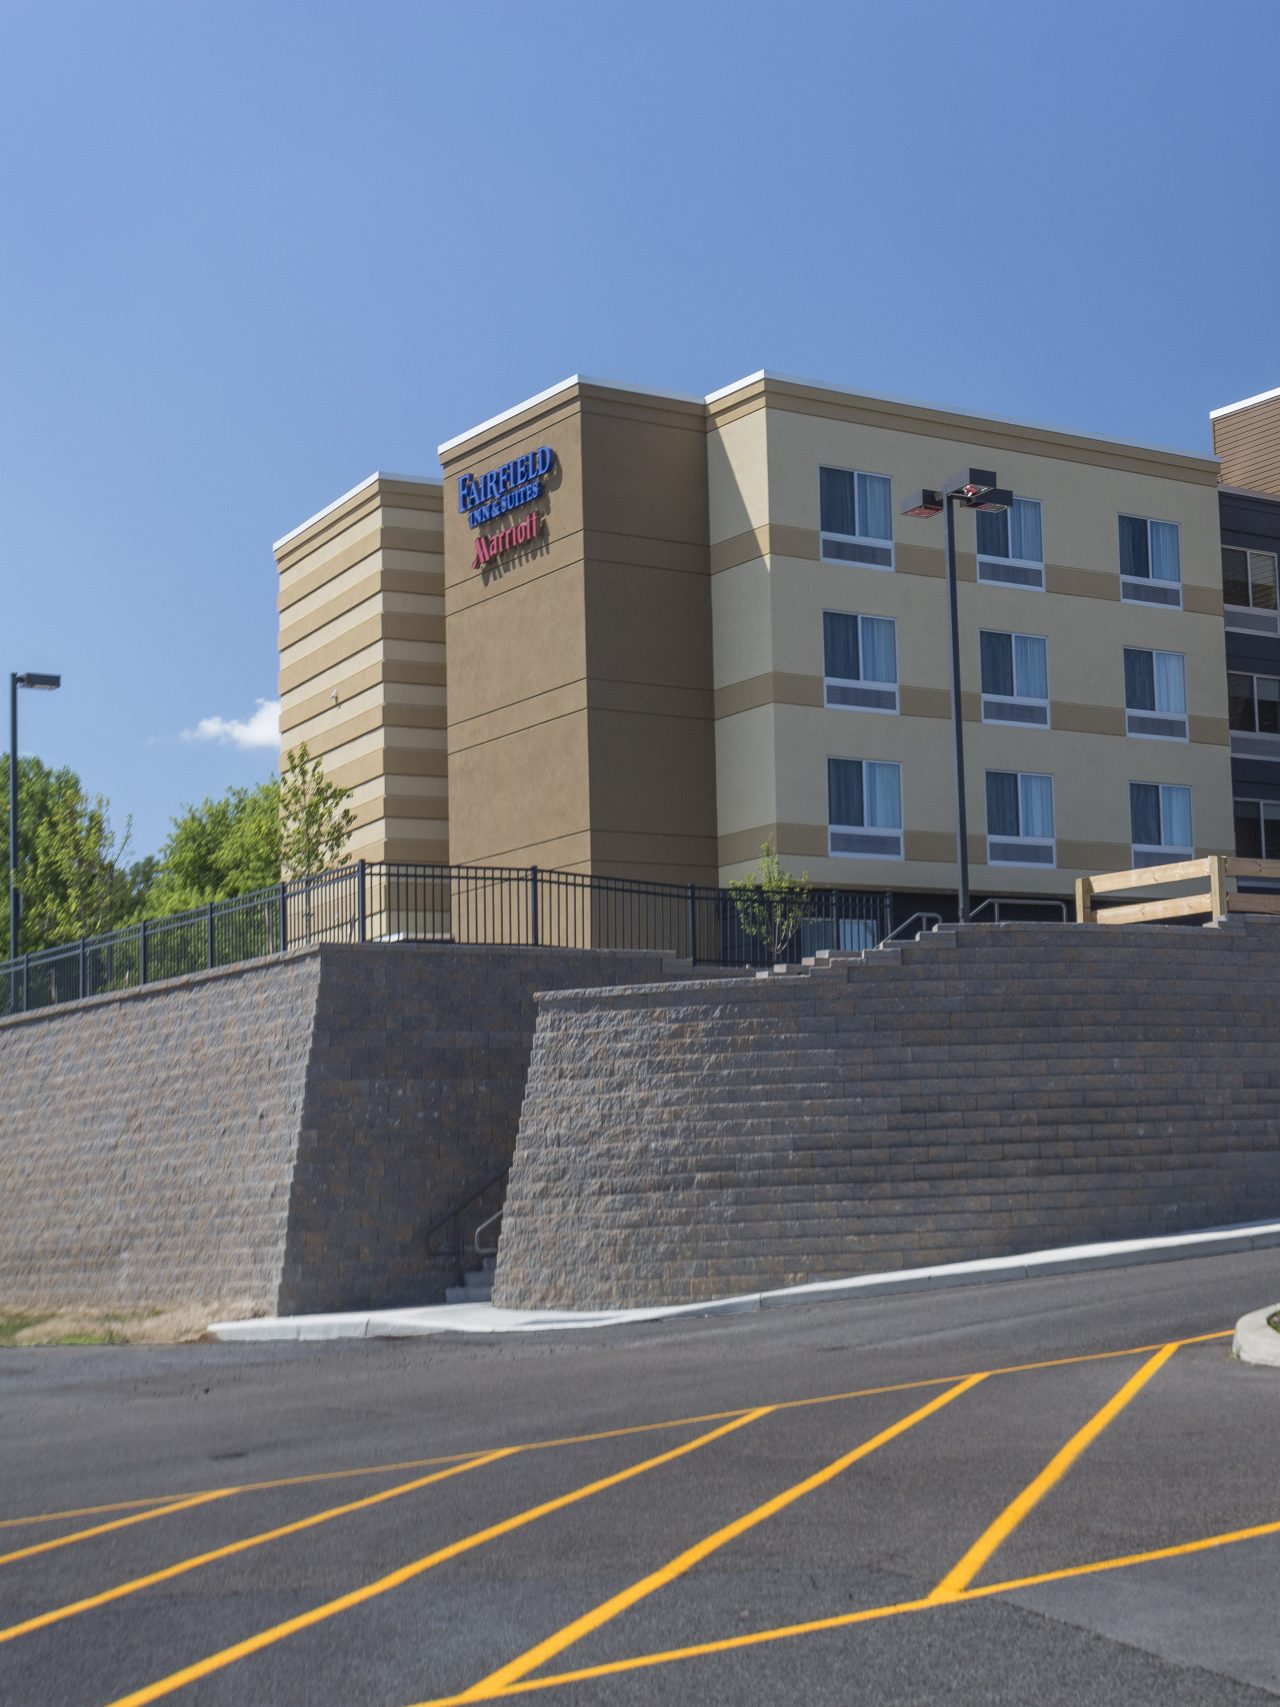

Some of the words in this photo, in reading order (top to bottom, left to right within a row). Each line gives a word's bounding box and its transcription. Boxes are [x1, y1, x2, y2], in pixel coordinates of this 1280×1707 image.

[457, 446, 554, 513] FAIRFIELD
[469, 504, 489, 529] INN
[501, 481, 542, 512] SUITES
[471, 511, 537, 570] Marriott
